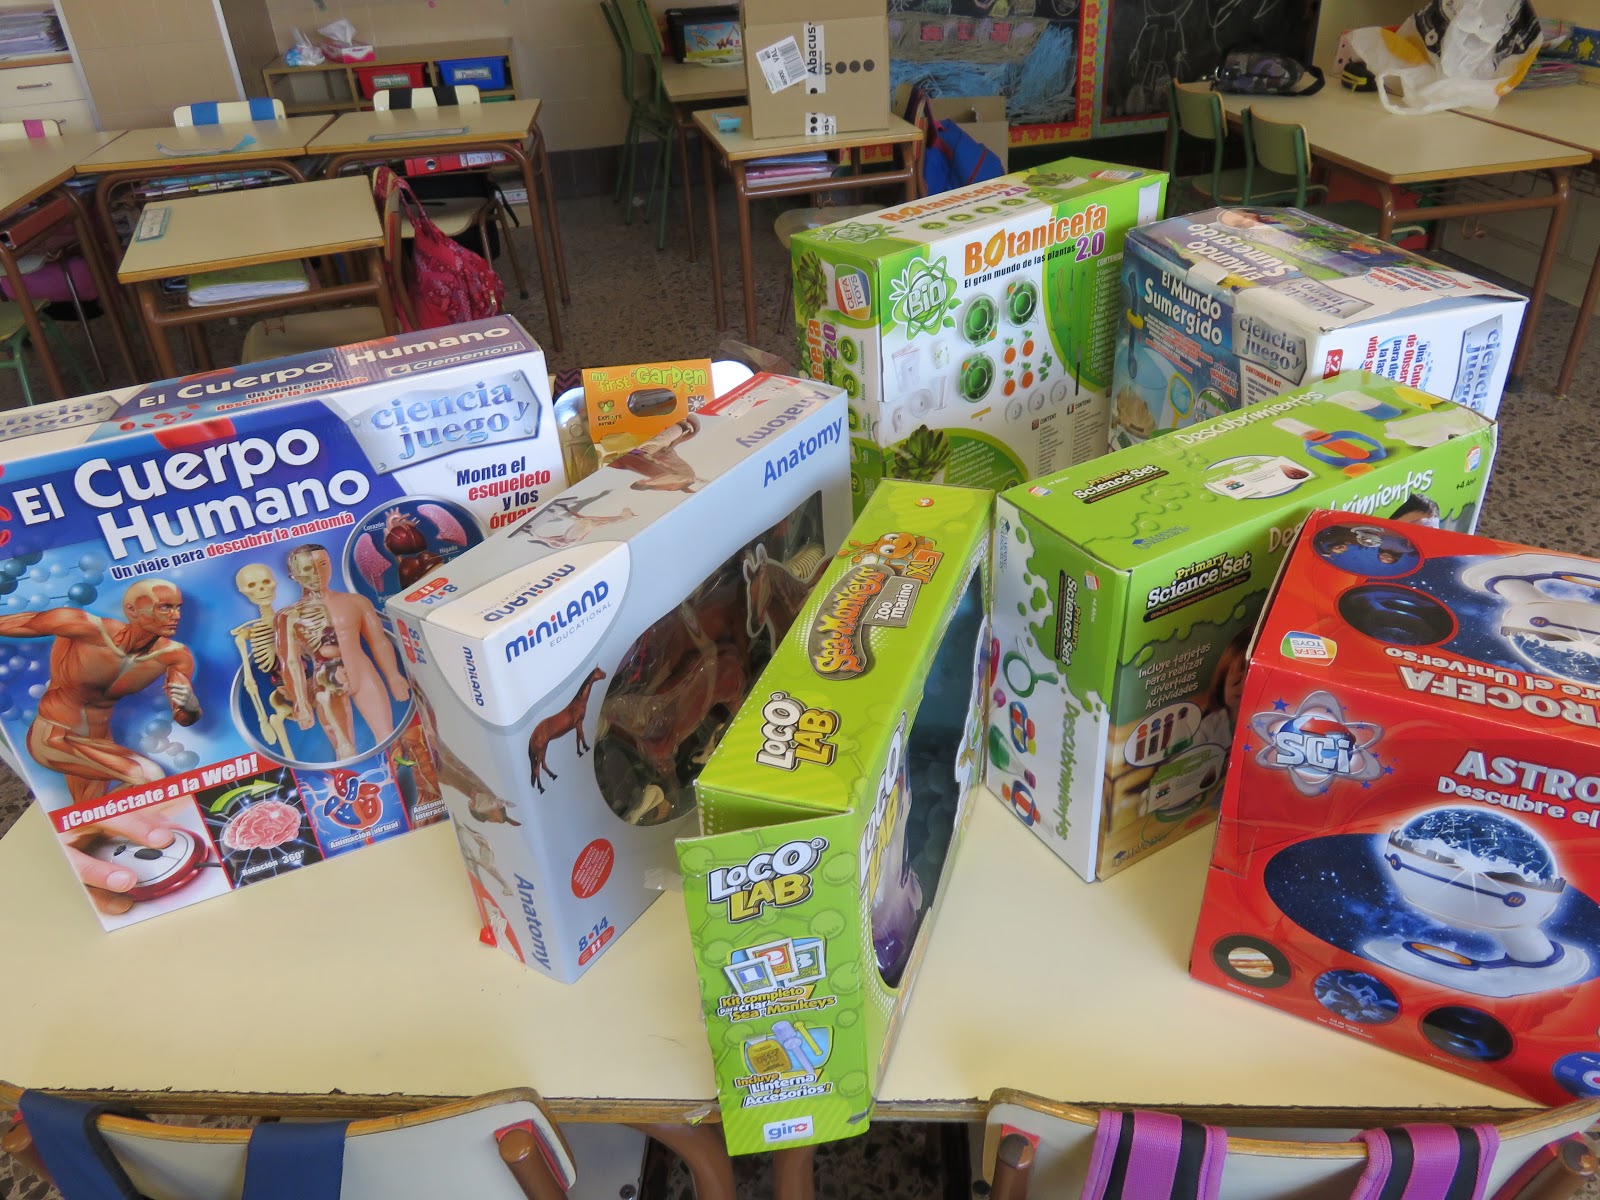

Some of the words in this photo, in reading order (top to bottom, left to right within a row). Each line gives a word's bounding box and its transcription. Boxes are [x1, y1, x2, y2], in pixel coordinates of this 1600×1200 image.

[807, 25, 817, 74] Abacus
[1075, 230, 1106, 263] 2.0
[1187, 241, 1251, 279] Mundo
[1188, 224, 1299, 277] Sumergido
[964, 277, 971, 288] El
[973, 273, 992, 287] gran
[993, 263, 1021, 280] mundo
[1022, 259, 1032, 269] de
[1033, 254, 1046, 265] las
[1047, 245, 1076, 263] plantas
[1248, 269, 1265, 281] El
[842, 278, 854, 309] CEFA
[851, 275, 864, 308] TOYS
[1161, 270, 1171, 288] El
[1170, 278, 1222, 320] Mundo
[1144, 278, 1223, 345] Sumergido
[1239, 316, 1297, 353] ciencia
[1366, 335, 1378, 359] vida
[1390, 339, 1402, 362] para
[1406, 333, 1417, 348] de
[139, 394, 166, 408] El
[176, 361, 334, 399] Cuerpo
[346, 327, 511, 366] Humano
[412, 343, 519, 371] Clementoni
[1242, 333, 1290, 370] juego
[1379, 347, 1389, 359] la
[1415, 343, 1428, 363] Una
[598, 376, 633, 393] first
[1470, 328, 1500, 414] ciencia
[216, 393, 285, 412] descubrir
[287, 389, 301, 398] la
[247, 390, 265, 399] Un
[267, 384, 303, 396] viaje
[304, 377, 337, 389] para
[0, 401, 95, 427] ncia
[371, 381, 515, 430] ciencia
[735, 389, 831, 449] Anatomy
[1174, 391, 1325, 445] Descubrimientos
[398, 413, 510, 460] juego
[513, 401, 530, 421] y
[763, 416, 843, 488] Anatomy
[12, 482, 65, 525] El
[74, 429, 320, 508] Cuerpo
[456, 463, 508, 487] Monta
[510, 456, 526, 473] el
[468, 469, 551, 501] esqueleto
[1072, 473, 1135, 500] Science
[1130, 464, 1161, 481] Set
[97, 470, 370, 560] Humano
[502, 495, 513, 511] y
[515, 489, 539, 507] los
[1268, 469, 1434, 554] Desrimientos
[363, 521, 386, 531] Corazón
[112, 565, 133, 580] Un
[134, 556, 170, 577] viaje
[172, 548, 206, 571] para
[207, 532, 274, 558] descubrir
[275, 527, 289, 542] la
[290, 511, 356, 537] anatomía
[905, 556, 935, 579] XL
[1146, 566, 1219, 610] Science
[1220, 552, 1251, 579] Set
[1175, 553, 1227, 580] Primary
[873, 601, 893, 621] zoo
[890, 583, 915, 620] marino
[1064, 575, 1078, 640] Science
[549, 601, 613, 649] EDUCATIONAL
[1062, 640, 1074, 666] Set
[1292, 639, 1322, 647] TOYS
[1294, 647, 1326, 656] CEFA
[1138, 658, 1171, 679] Incluye
[1173, 642, 1211, 666] tarjetas
[1145, 674, 1166, 690] para
[1168, 656, 1206, 679] realizar
[1384, 647, 1518, 687] Universo
[1524, 675, 1554, 690] el
[1145, 682, 1199, 711] Actividades
[1150, 671, 1197, 696] divertidas
[1398, 665, 1600, 729] ROCEFA
[795, 708, 837, 766] LAB
[1053, 700, 1081, 841] Descubrimientos
[1454, 749, 1600, 803] ASTRO
[62, 788, 165, 831] ¡Conéctate
[168, 785, 179, 798] a
[181, 777, 200, 793] la
[1437, 776, 1565, 818] Descubre
[1571, 810, 1600, 828] el
[329, 829, 372, 850] Animación
[373, 821, 399, 836] virtual
[241, 859, 279, 877] Rotación
[730, 874, 811, 921] LAB
[513, 873, 552, 971] Anatomy
[719, 1006, 739, 1015] para
[739, 1002, 768, 1012] criar
[722, 997, 742, 1007] Kit
[743, 987, 804, 1004] completo
[766, 996, 835, 1016] Monkeys
[736, 1074, 780, 1086] Incluye
[743, 1083, 832, 1107] Accesorios!
[751, 1074, 816, 1094] Linterna
[768, 1122, 808, 1140] giro
